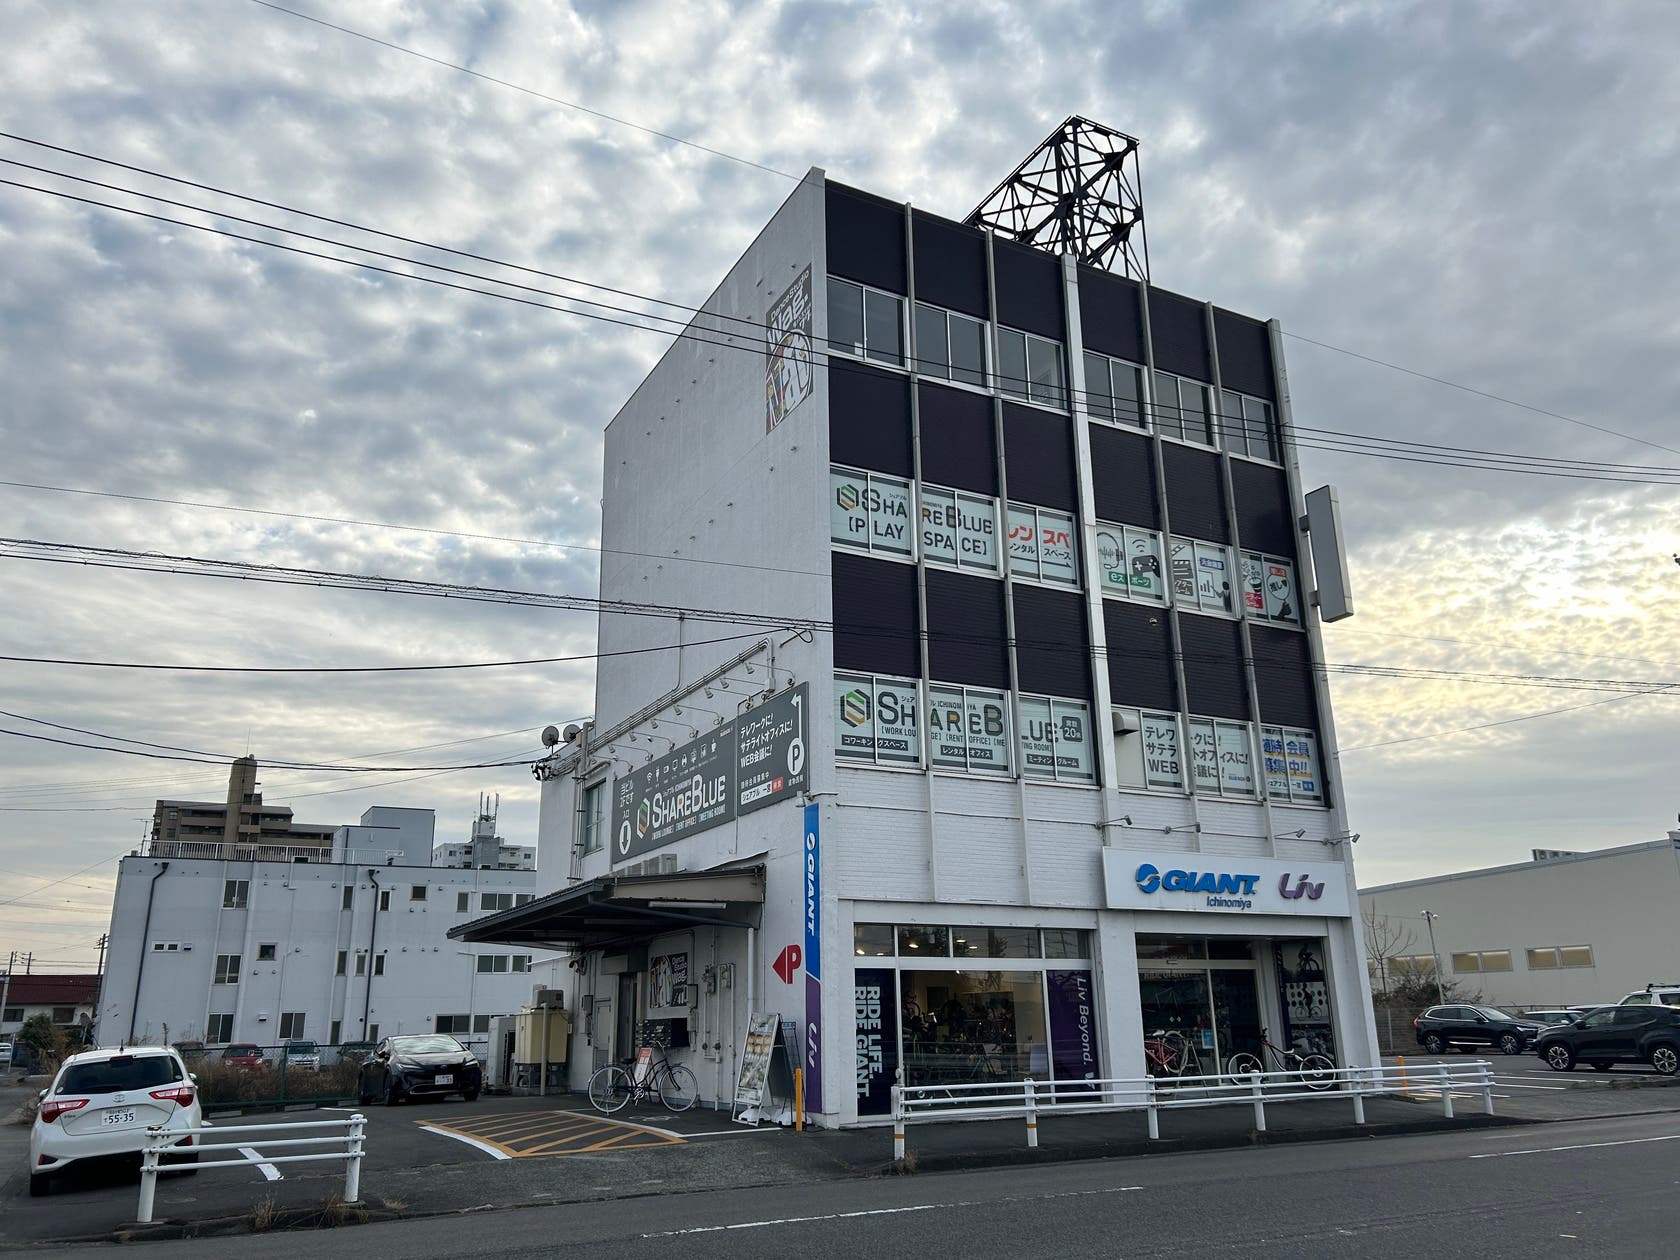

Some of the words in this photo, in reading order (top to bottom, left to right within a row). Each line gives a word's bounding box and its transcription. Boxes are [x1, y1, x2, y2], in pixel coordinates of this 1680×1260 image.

[770, 294, 790, 321] Dance
[789, 270, 810, 298] Studio
[740, 712, 774, 739] テレワークに!
[740, 719, 793, 753] サテライトオフィスに!
[740, 744, 773, 768] WEB会議に!
[792, 743, 801, 771] P
[805, 852, 817, 937] GIANT
[1162, 868, 1260, 895] GIANT
[1278, 872, 1326, 901] Liv
[1206, 896, 1253, 911] Ichinomiya
[1076, 977, 1087, 1001] Liv
[855, 986, 869, 1029] RIDE
[865, 985, 882, 1029] RIDE
[1078, 1005, 1091, 1066] Beyond.
[868, 1031, 883, 1079] LIFE.
[108, 1112, 134, 1124] 55-35
